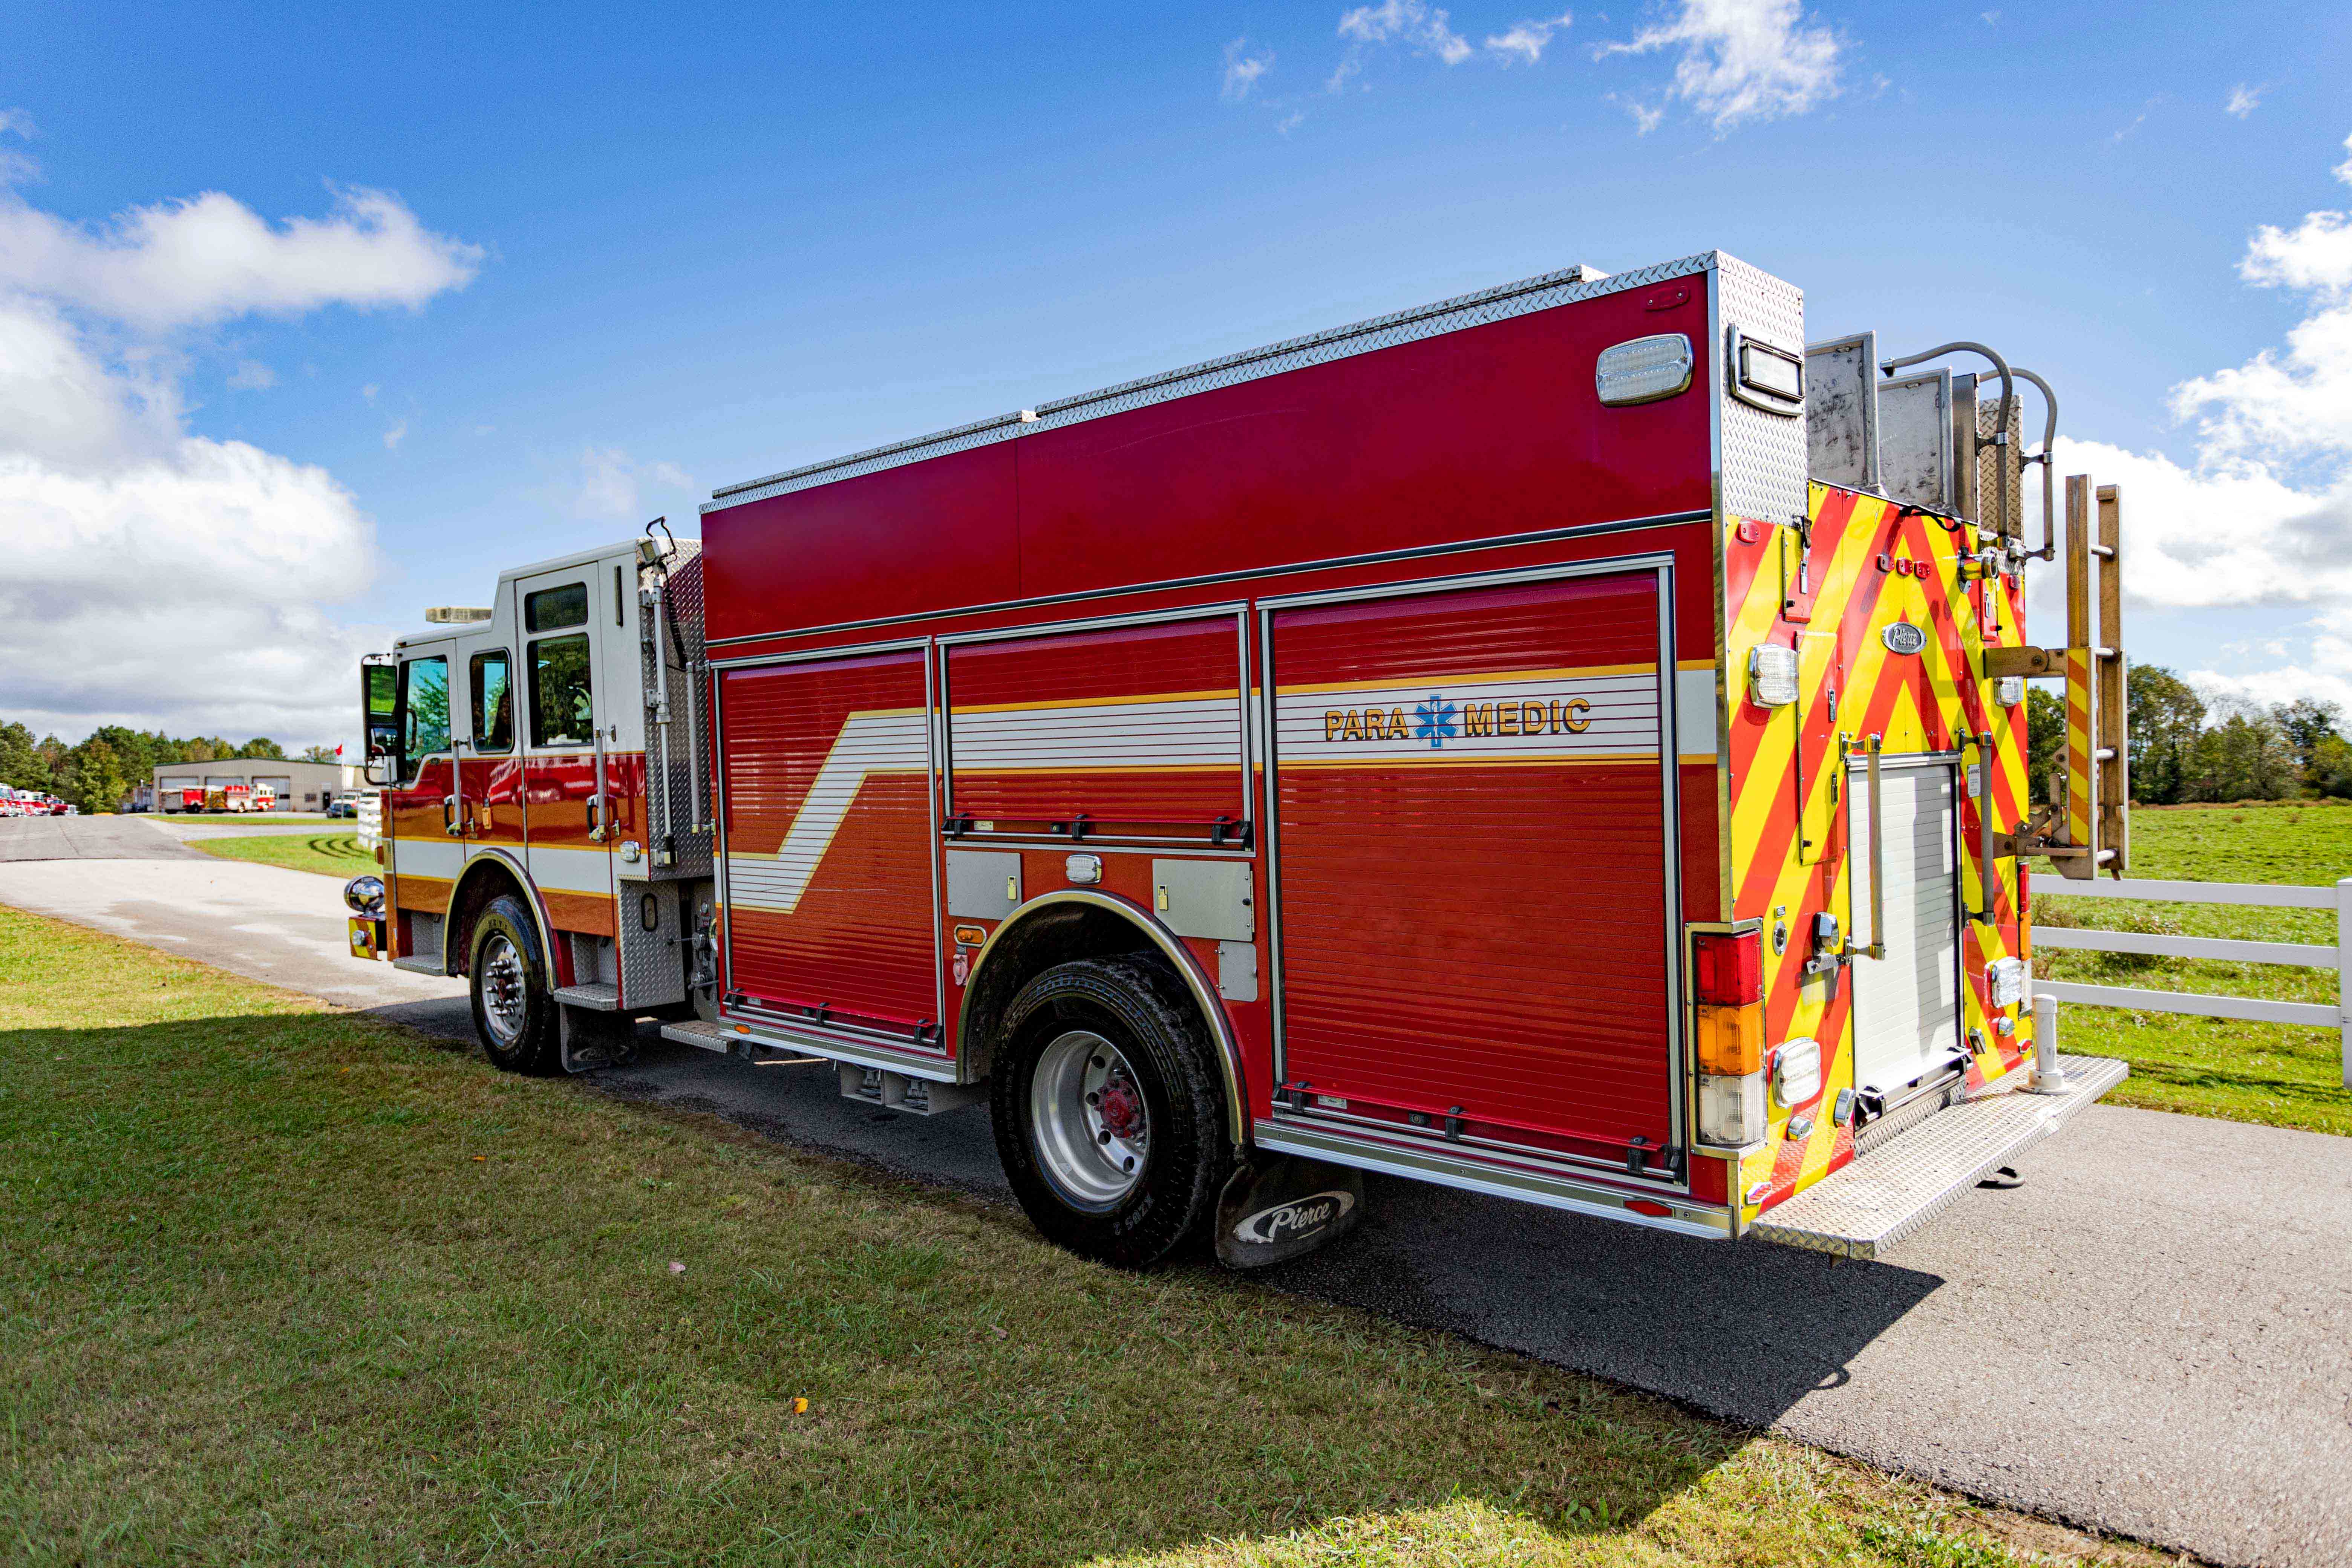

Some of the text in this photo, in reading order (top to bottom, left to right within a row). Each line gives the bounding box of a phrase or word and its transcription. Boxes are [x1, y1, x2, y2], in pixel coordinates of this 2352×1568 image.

[1325, 698, 1591, 741] PARA MEDIC
[1268, 1202, 1330, 1238] Pierce
